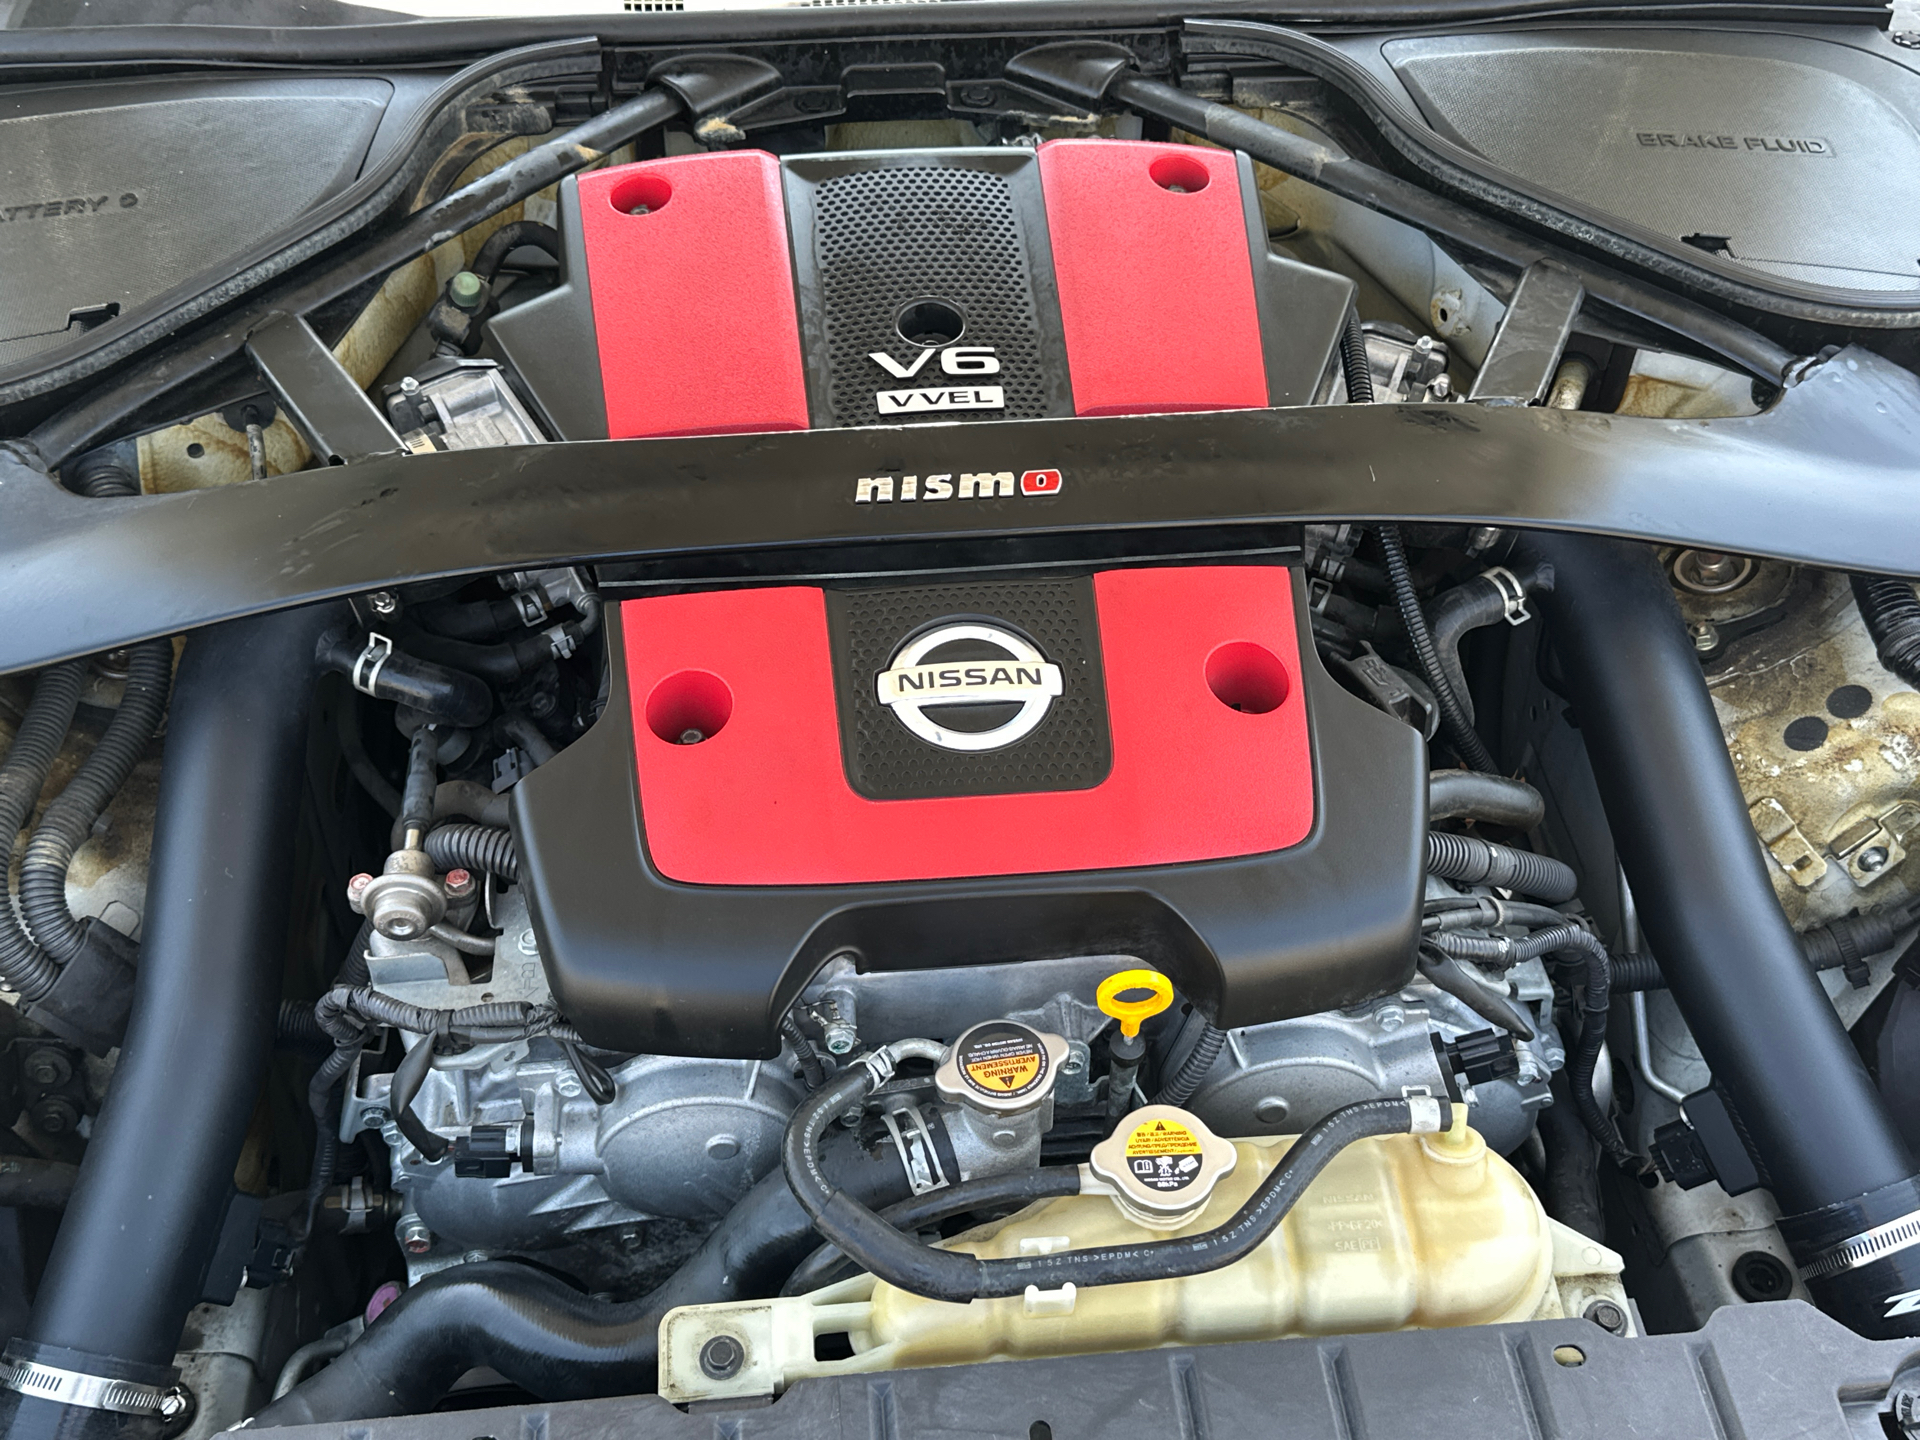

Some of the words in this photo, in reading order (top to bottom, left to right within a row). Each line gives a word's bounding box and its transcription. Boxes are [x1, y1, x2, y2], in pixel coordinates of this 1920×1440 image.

[1636, 132, 1738, 149] BRAKE
[1743, 136, 1826, 153] FLUID
[0, 195, 109, 222] TTERY
[868, 346, 1000, 379] V6
[888, 390, 994, 407] VVEL
[855, 468, 1063, 502] nismo
[898, 667, 1042, 692] NISSAN
[971, 1056, 1036, 1072] AVERTISSEMENT
[983, 1065, 1029, 1078] WARNING
